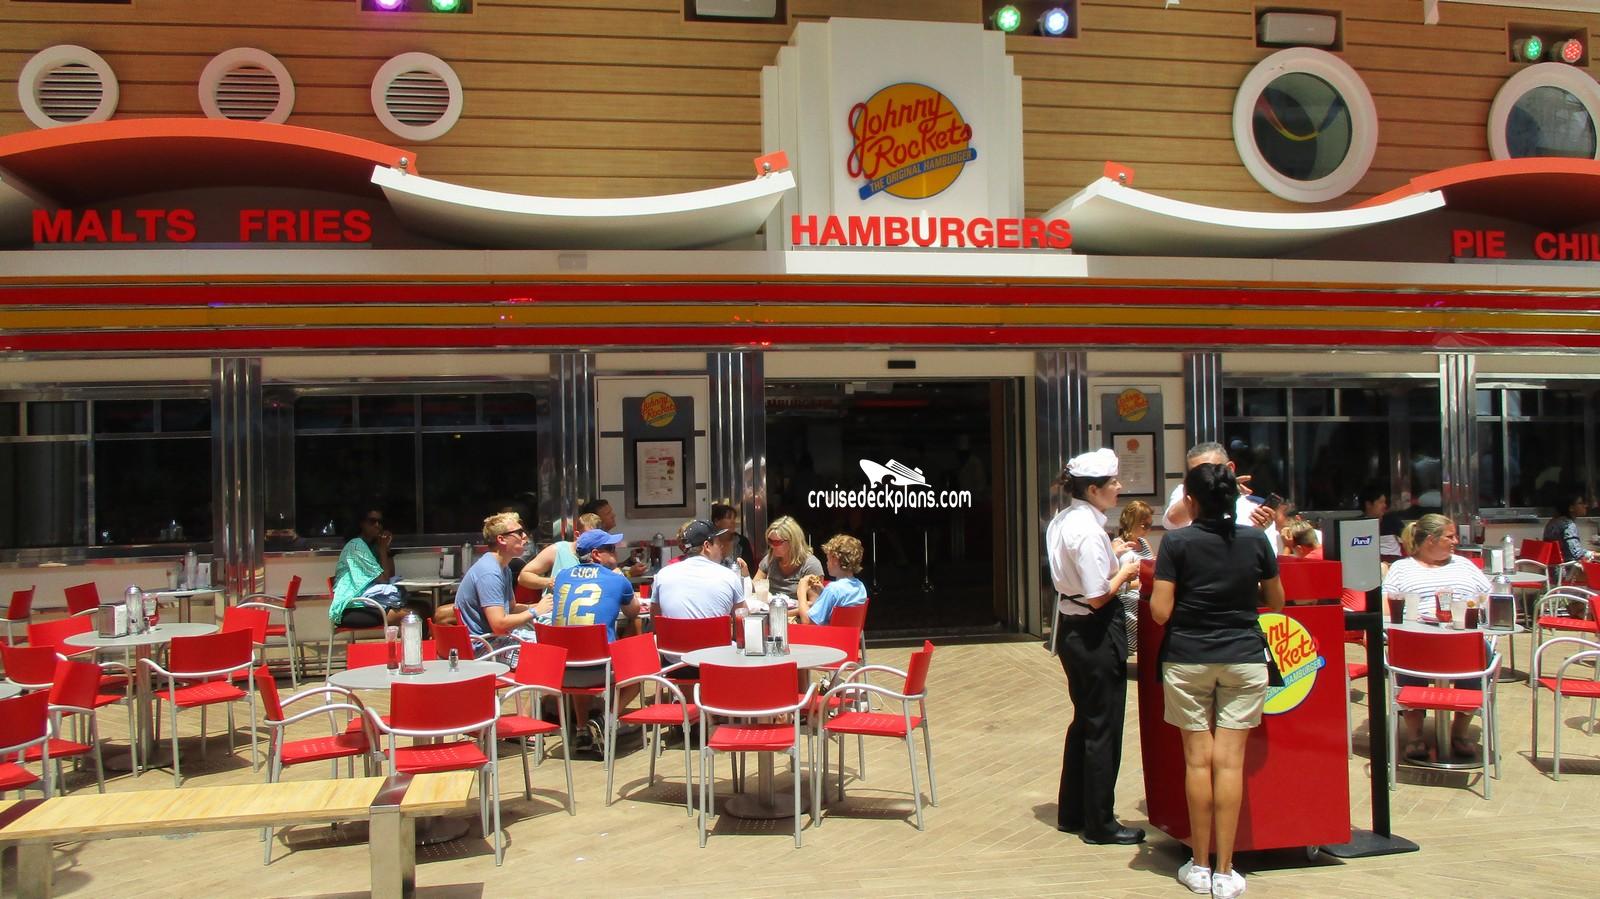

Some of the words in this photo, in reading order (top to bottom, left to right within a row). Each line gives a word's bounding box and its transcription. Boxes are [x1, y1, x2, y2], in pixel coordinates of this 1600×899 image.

[847, 92, 953, 178] Johnny
[864, 118, 973, 179] Rockets
[870, 179, 886, 193] THE
[886, 163, 922, 185] ORIGINAL
[923, 150, 972, 172] HAMBURGER
[32, 209, 197, 242] MALTS
[239, 209, 372, 242] FRIES
[791, 215, 1073, 248] HAMBURGERS
[1453, 229, 1506, 258] PIE
[570, 567, 599, 578] LUCK
[556, 583, 602, 626] 12
[1284, 659, 1322, 687] HAMBURGER
